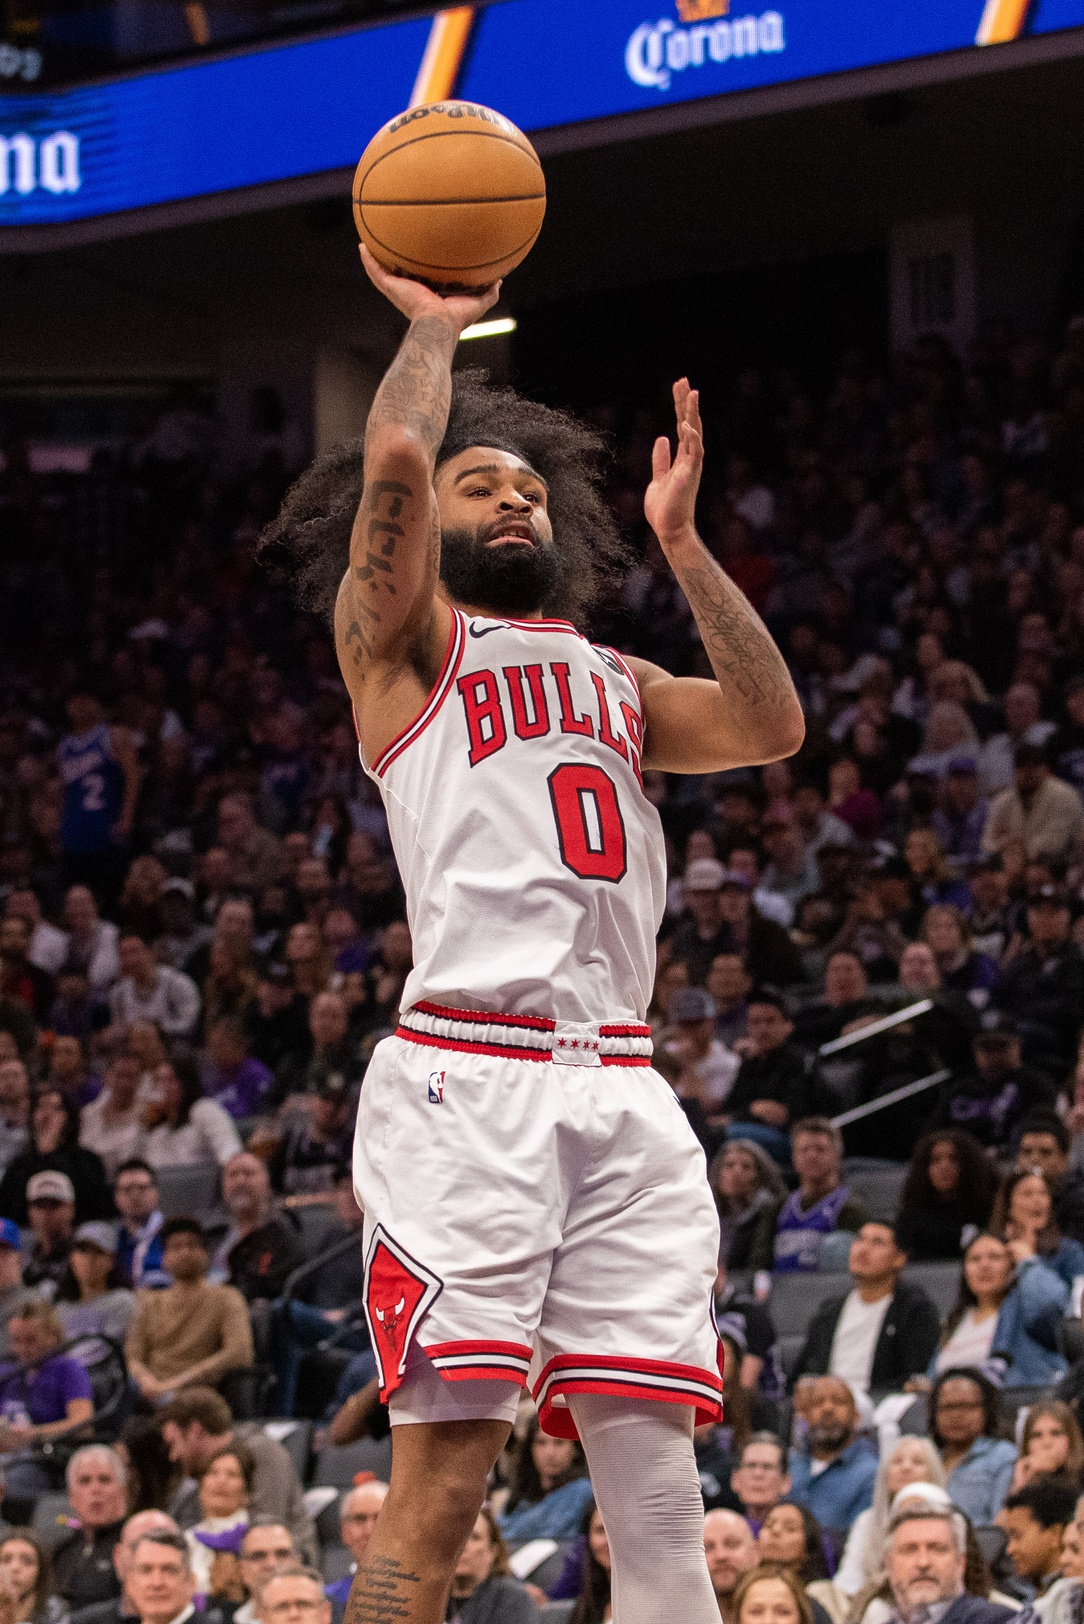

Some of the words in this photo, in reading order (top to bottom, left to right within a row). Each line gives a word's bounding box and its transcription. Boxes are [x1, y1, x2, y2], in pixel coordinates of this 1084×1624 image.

[625, 10, 785, 92] Corona
[456, 662, 643, 791] BULLS
[81, 773, 104, 811] 2
[546, 762, 628, 884] 0
